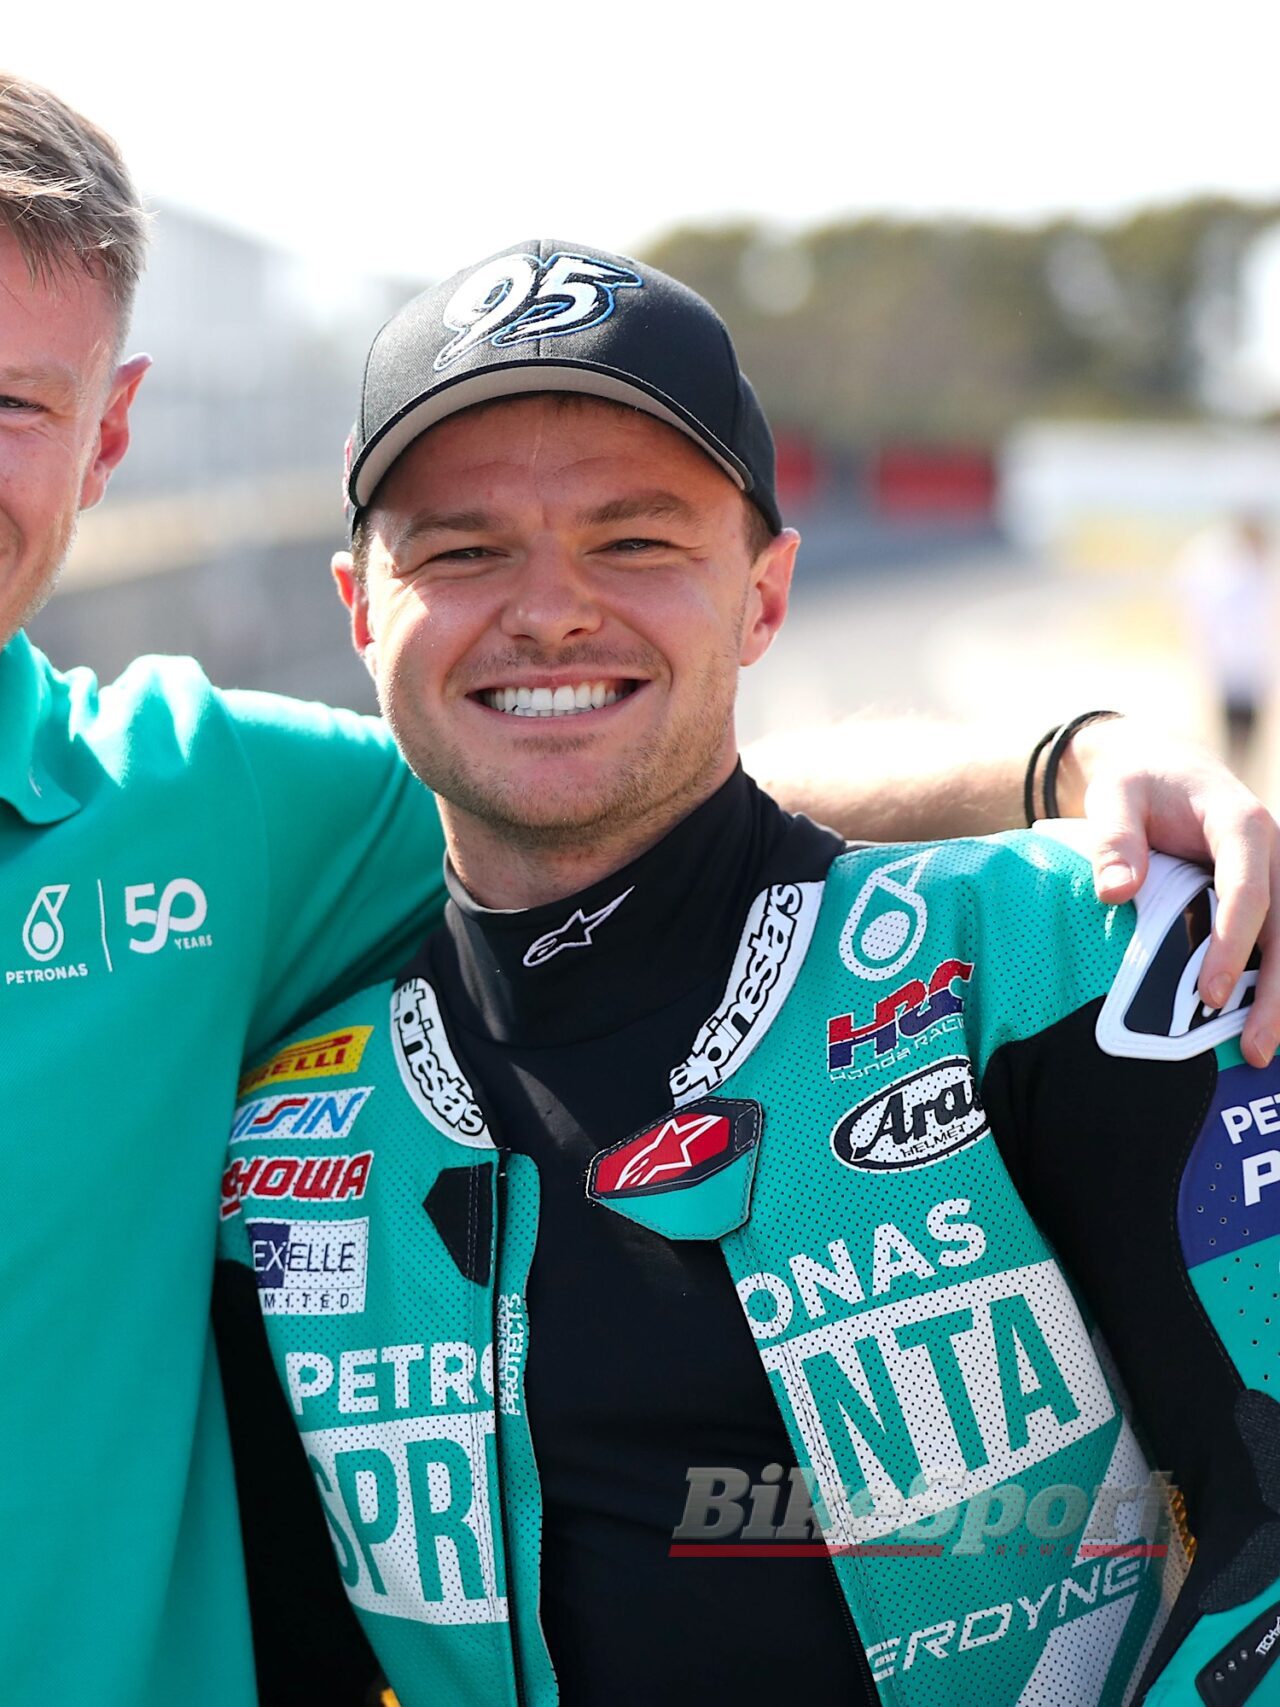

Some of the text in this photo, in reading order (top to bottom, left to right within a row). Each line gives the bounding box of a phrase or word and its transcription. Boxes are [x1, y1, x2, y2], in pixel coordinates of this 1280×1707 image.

[433, 252, 643, 371] 95
[125, 878, 208, 954] 50
[174, 934, 213, 950] YEARS
[5, 962, 89, 985] PETRONAS
[827, 958, 975, 1073] HRC
[900, 1123, 966, 1158] HELMET
[505, 1292, 525, 1416] PROTECTS
